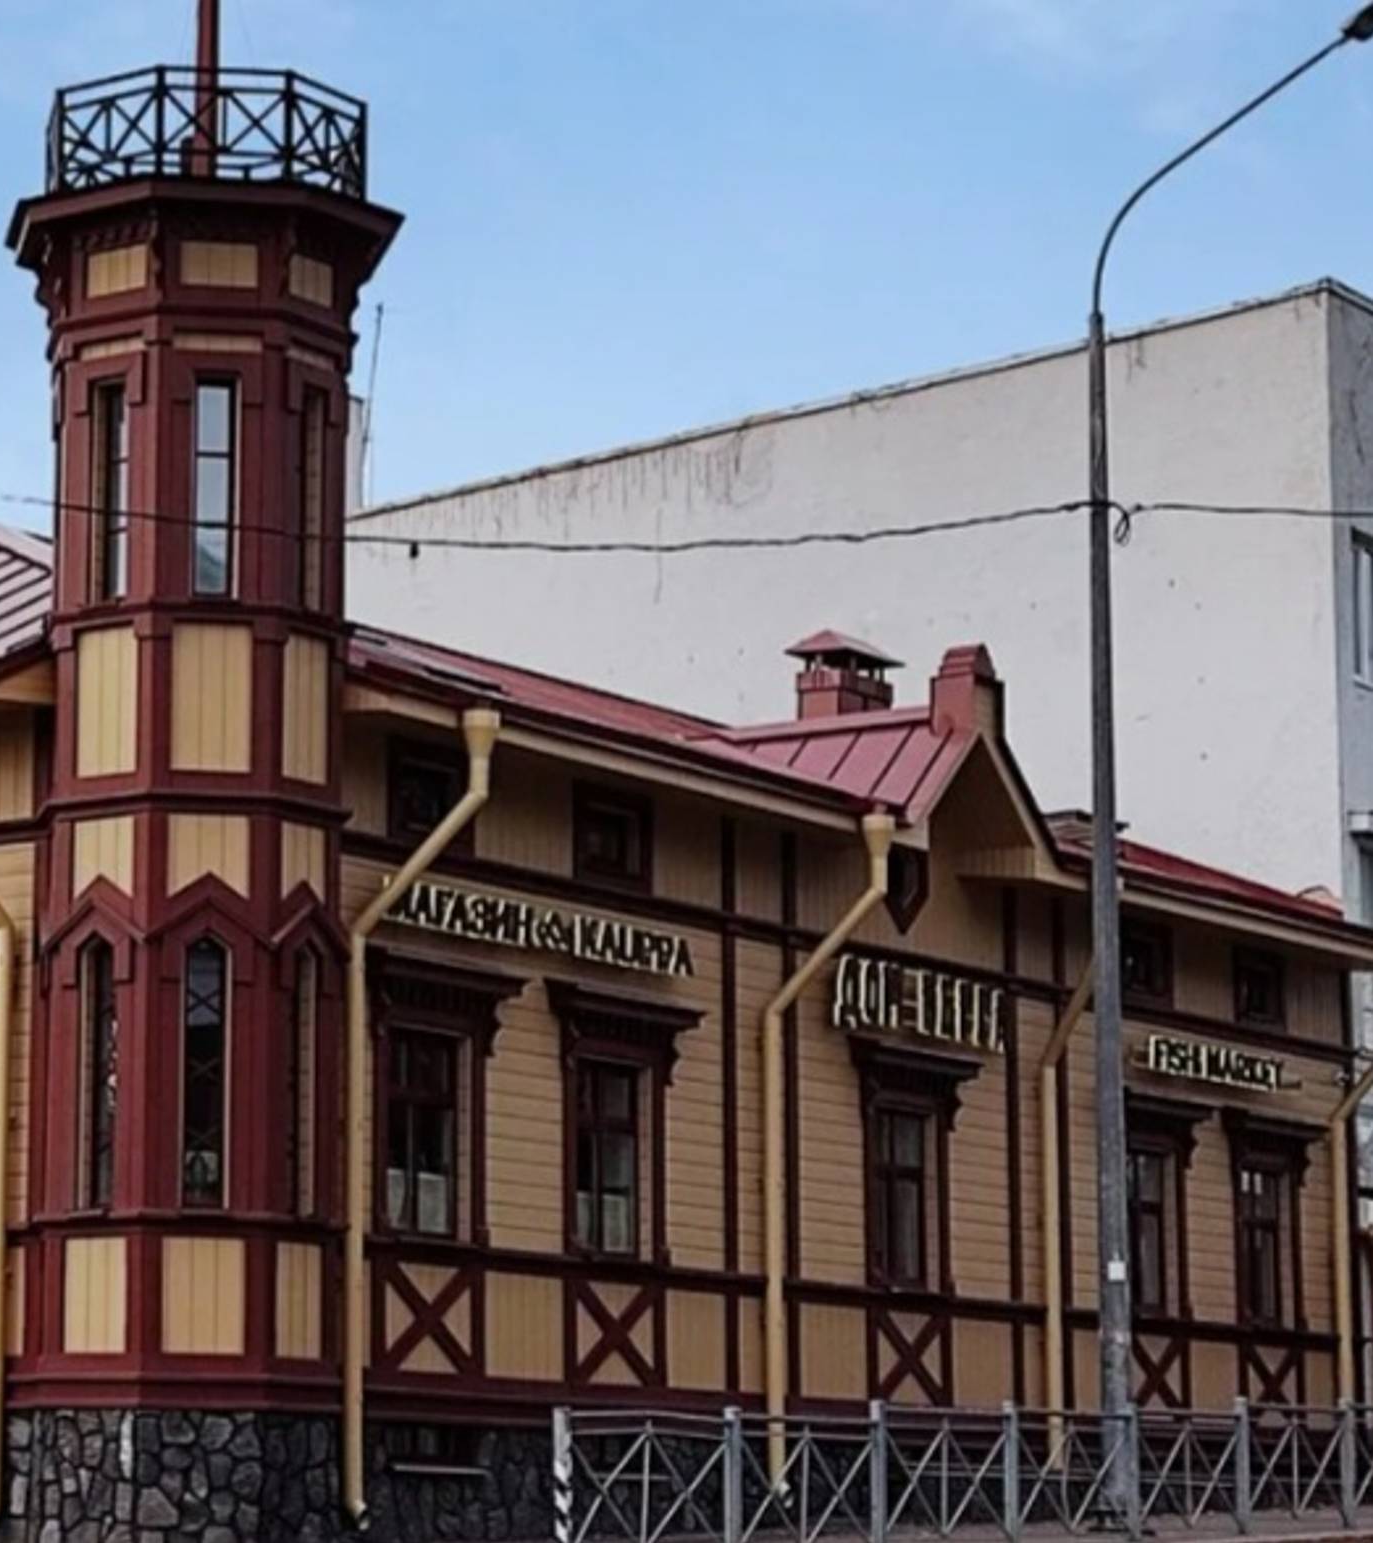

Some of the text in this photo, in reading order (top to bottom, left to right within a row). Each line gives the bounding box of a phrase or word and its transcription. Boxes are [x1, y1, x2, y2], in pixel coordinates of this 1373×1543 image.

[573, 913, 694, 977] KAUPPA
[1149, 1035, 1284, 1093] FISH MARKET
